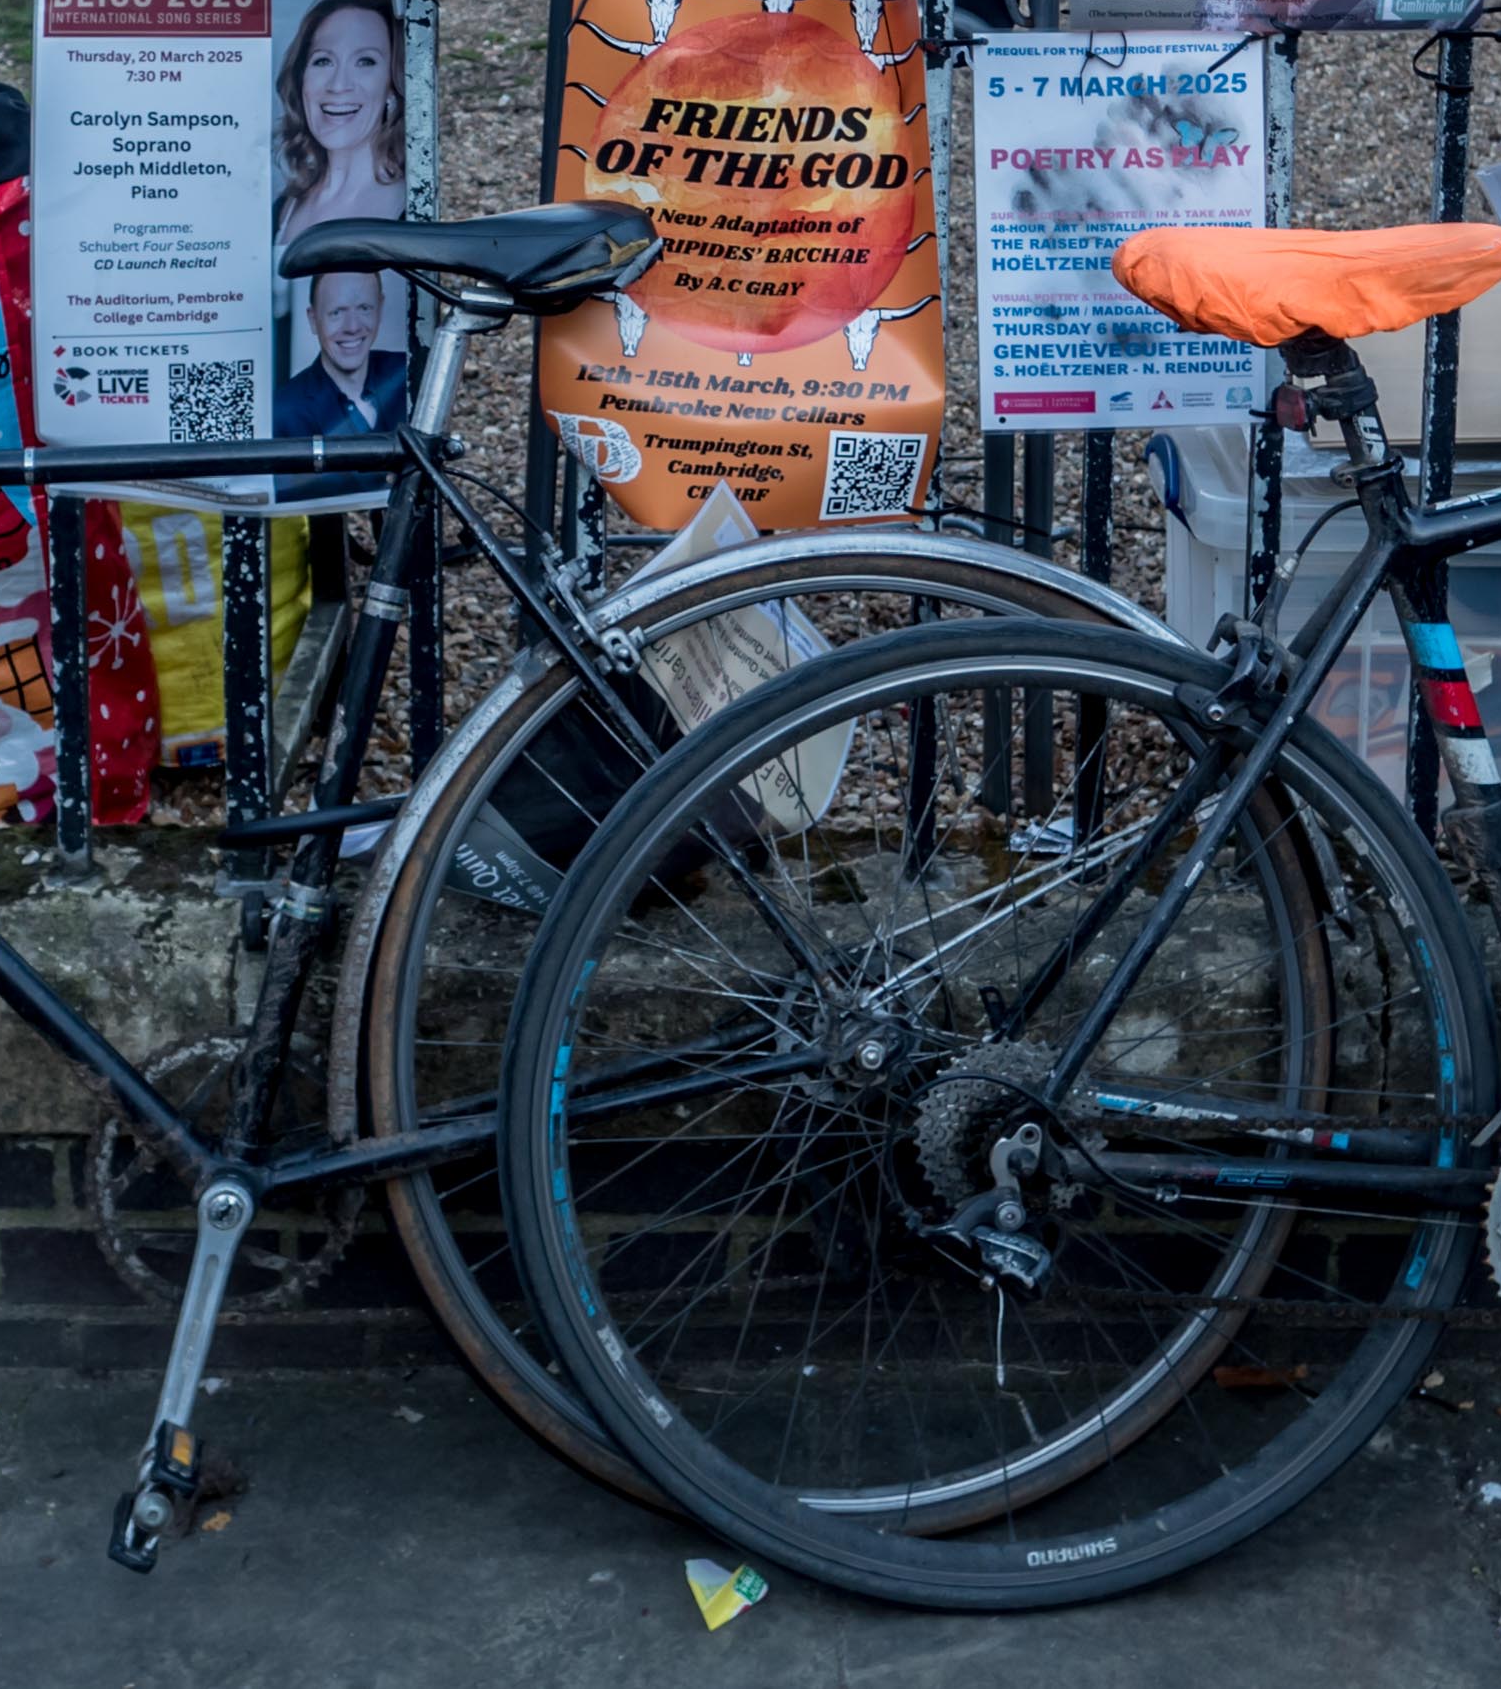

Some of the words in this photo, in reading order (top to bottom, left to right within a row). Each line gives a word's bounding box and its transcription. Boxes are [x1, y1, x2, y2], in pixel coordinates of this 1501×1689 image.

[51, 12, 152, 25] INTERNATIONAL
[157, 12, 191, 24] SONG
[195, 12, 242, 25] SERIES
[1060, 75, 1166, 97] MARCH
[1178, 72, 1247, 94] 2025
[70, 111, 142, 130] Carolyn
[147, 111, 239, 130] Sampson,
[640, 98, 872, 143] FRIENDS
[112, 138, 191, 156] Soprano
[595, 139, 673, 177] OF
[683, 148, 795, 189] THE
[800, 152, 909, 190] GOD
[990, 148, 1116, 170] POETRY
[1123, 147, 1164, 168] AS
[1172, 145, 1250, 167] PLAY
[73, 162, 134, 178] Joseph
[139, 161, 231, 177] Middleton,
[131, 186, 178, 199] Piano
[658, 209, 707, 229] New
[711, 214, 834, 236] Adaptation
[837, 217, 864, 234] of
[94, 259, 113, 270] CD
[117, 258, 166, 270] Launch
[170, 257, 217, 269] Recital
[994, 340, 1122, 360] GENEVIÈVE
[1126, 341, 1252, 357] GUETEMME
[98, 377, 149, 394] LIVE
[599, 393, 722, 419] Pembroke
[725, 401, 776, 421] New
[781, 405, 865, 426] Cellars
[1026, 1536, 1118, 1568] SHIMANO
